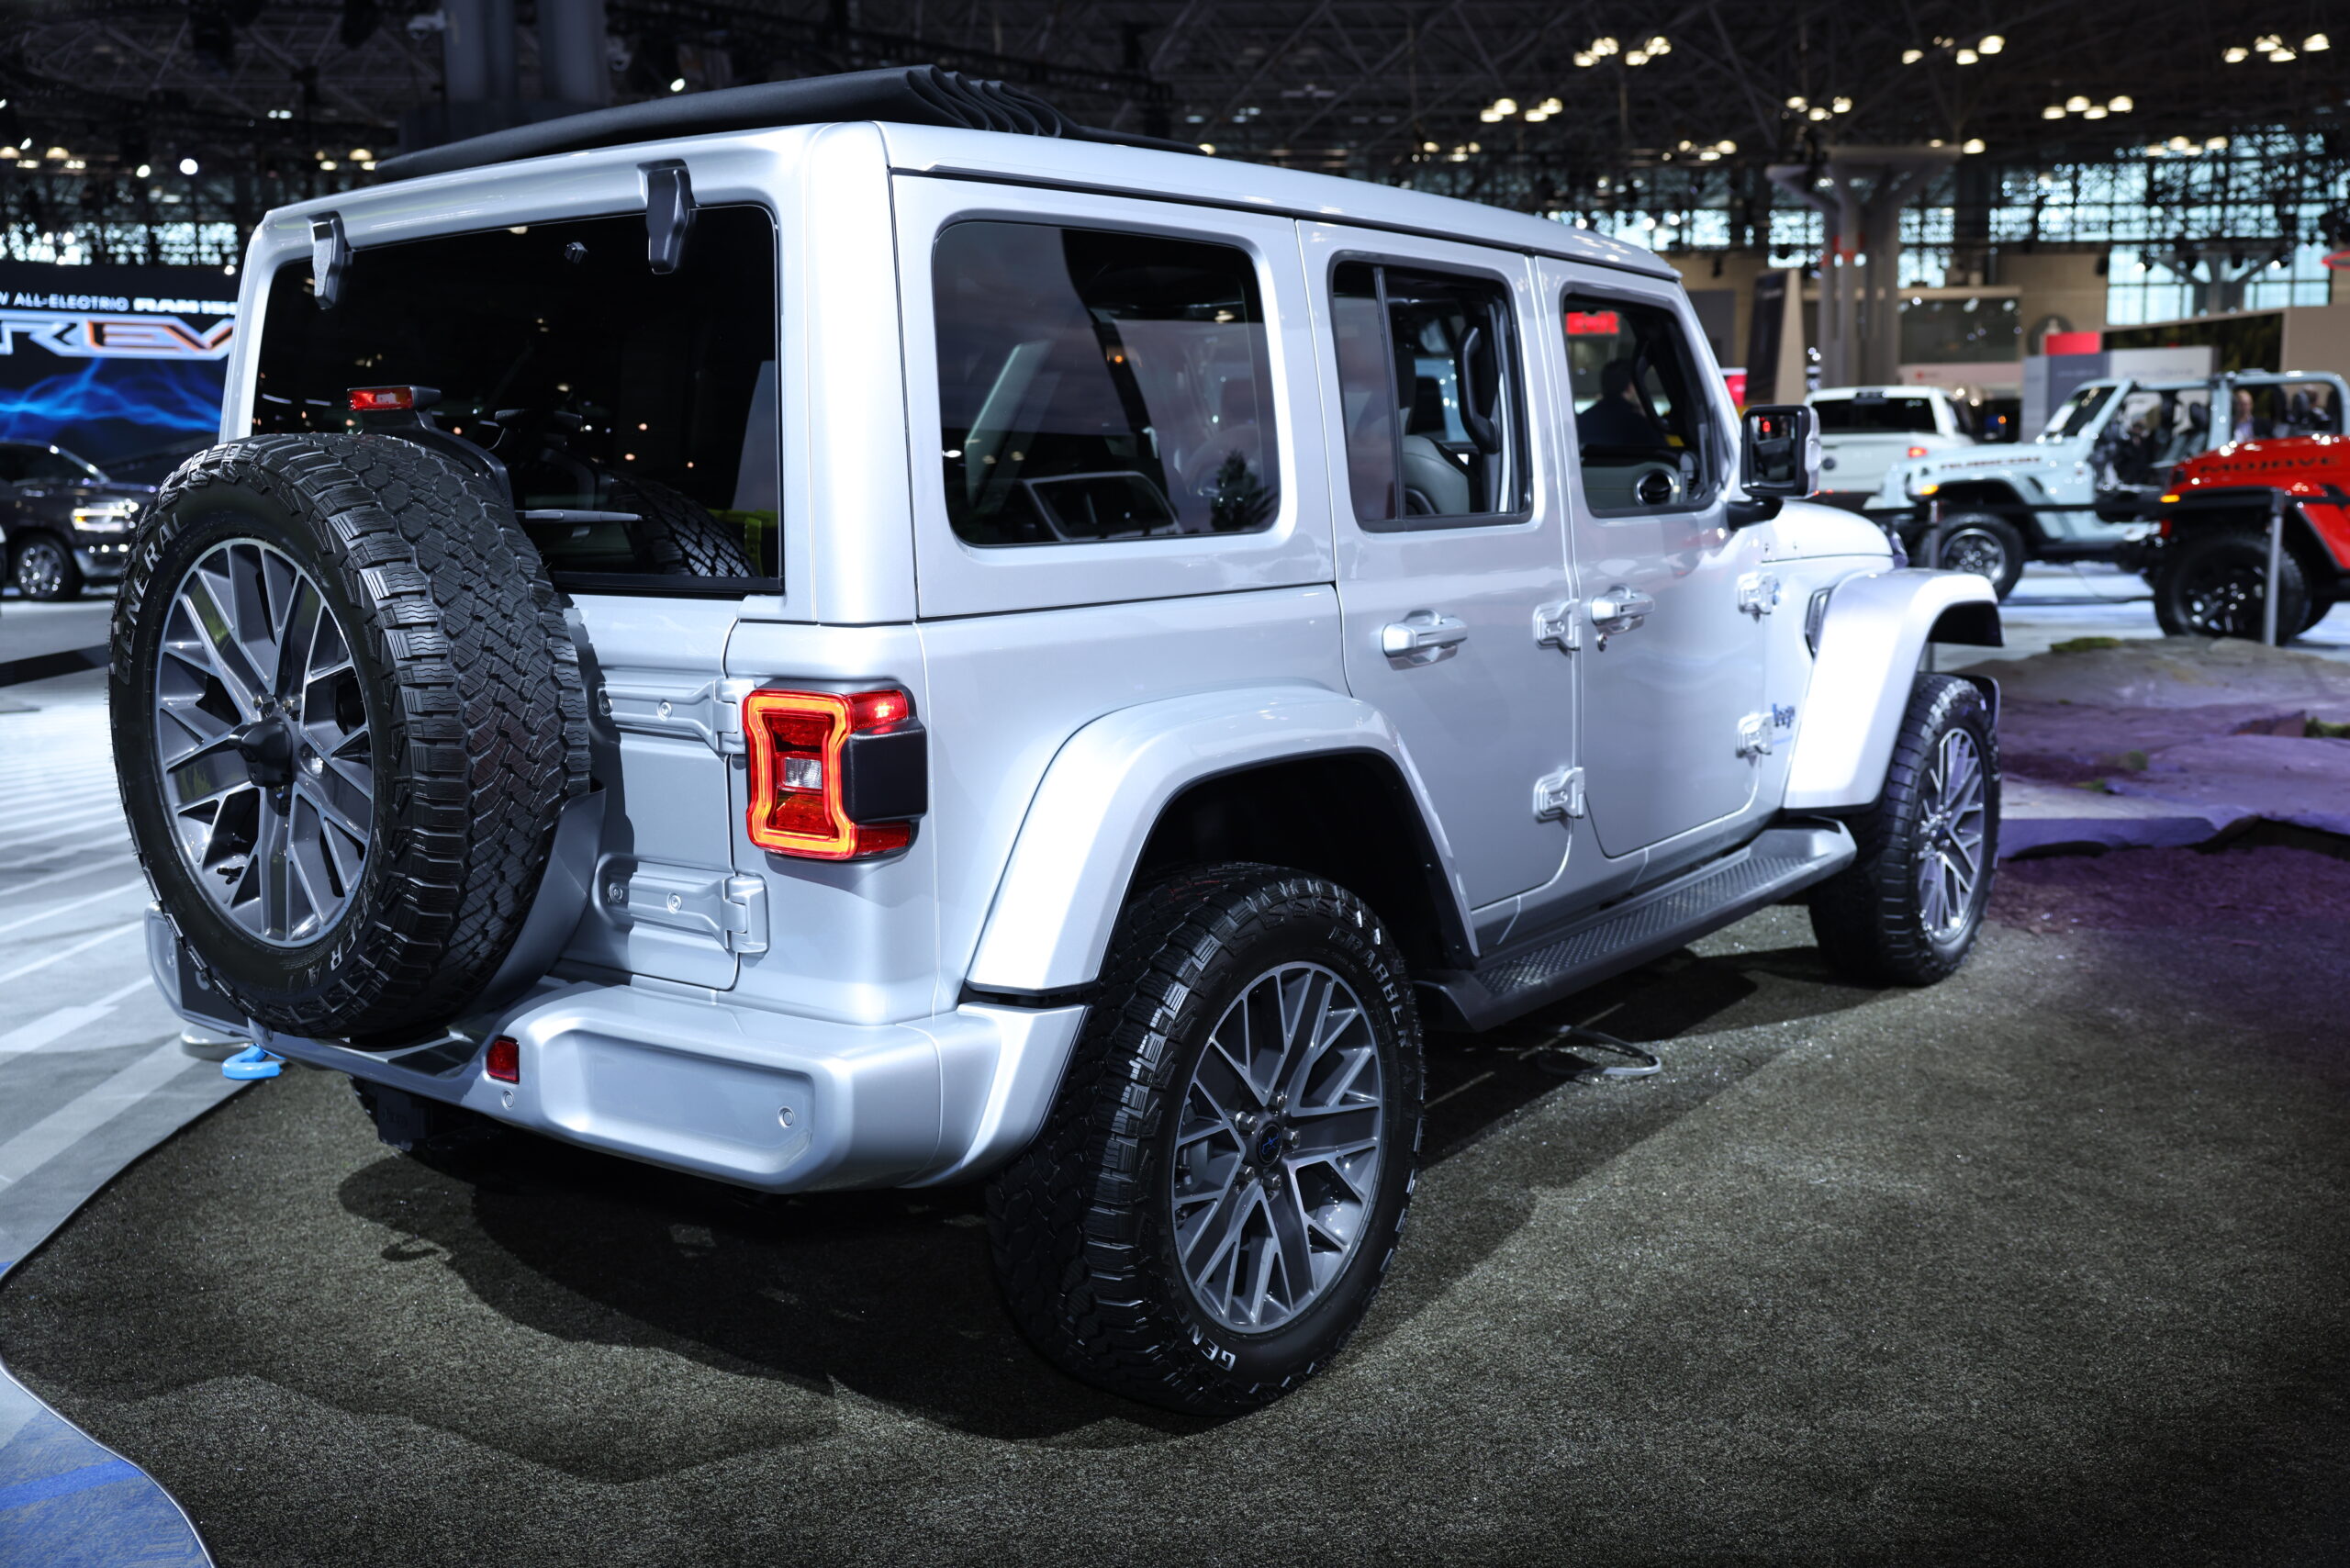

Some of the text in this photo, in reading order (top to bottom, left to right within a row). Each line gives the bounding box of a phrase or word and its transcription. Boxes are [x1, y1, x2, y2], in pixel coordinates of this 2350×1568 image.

[14, 292, 129, 312] ALL-ELECTRIC
[133, 297, 199, 314] RAM
[2199, 457, 2340, 473] MOJAVE
[117, 512, 188, 685] GENERAL
